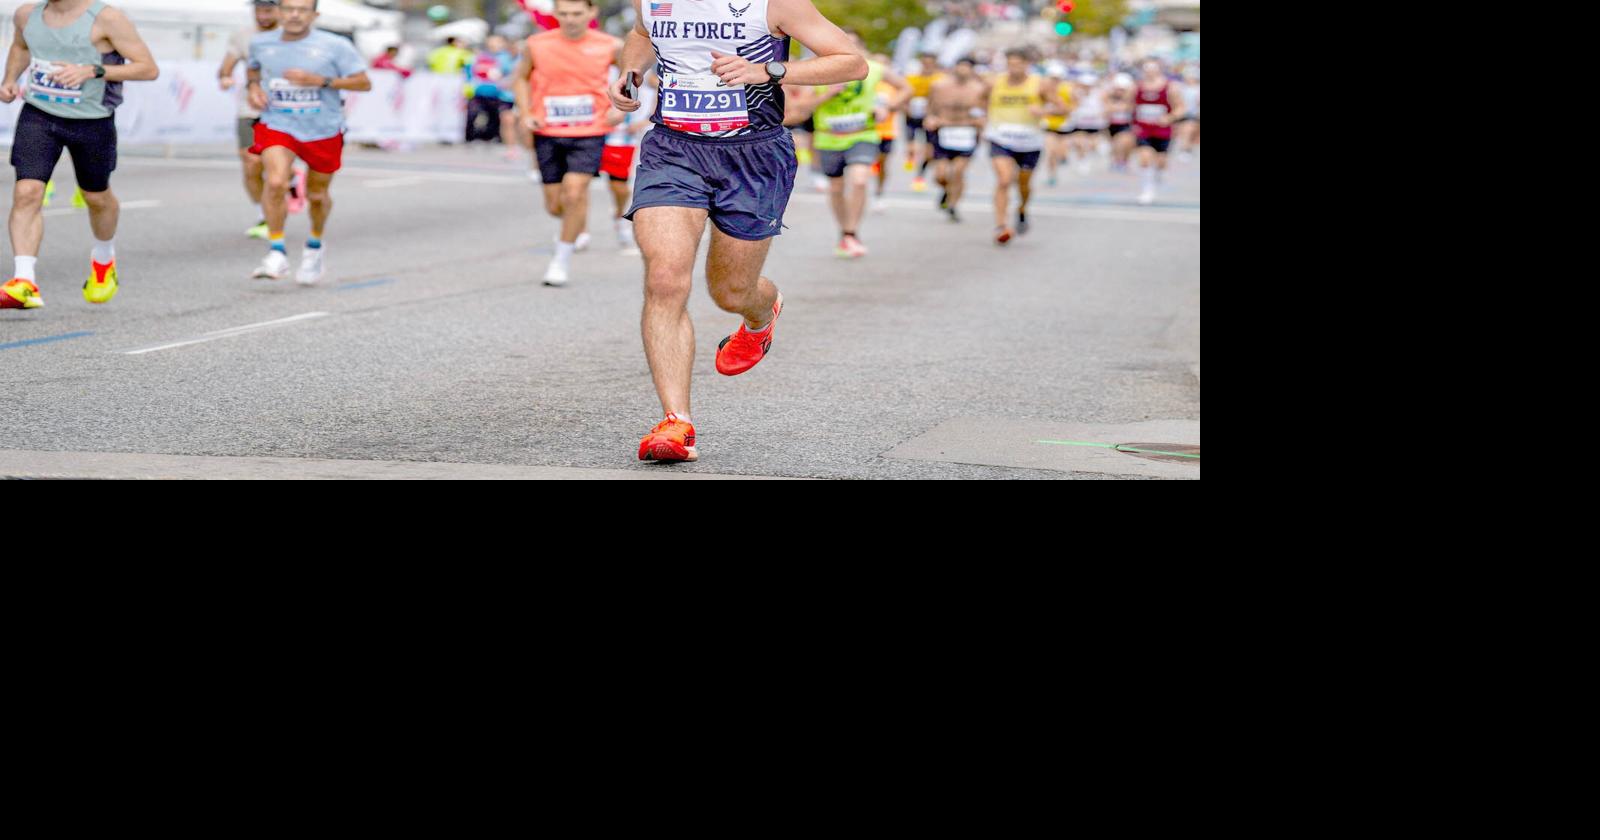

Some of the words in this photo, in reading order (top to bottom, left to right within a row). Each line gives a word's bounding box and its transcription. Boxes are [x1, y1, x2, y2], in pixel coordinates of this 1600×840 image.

[652, 20, 677, 38] AIR
[682, 22, 746, 39] FORCE
[664, 92, 677, 108] B
[682, 92, 741, 110] 17291
